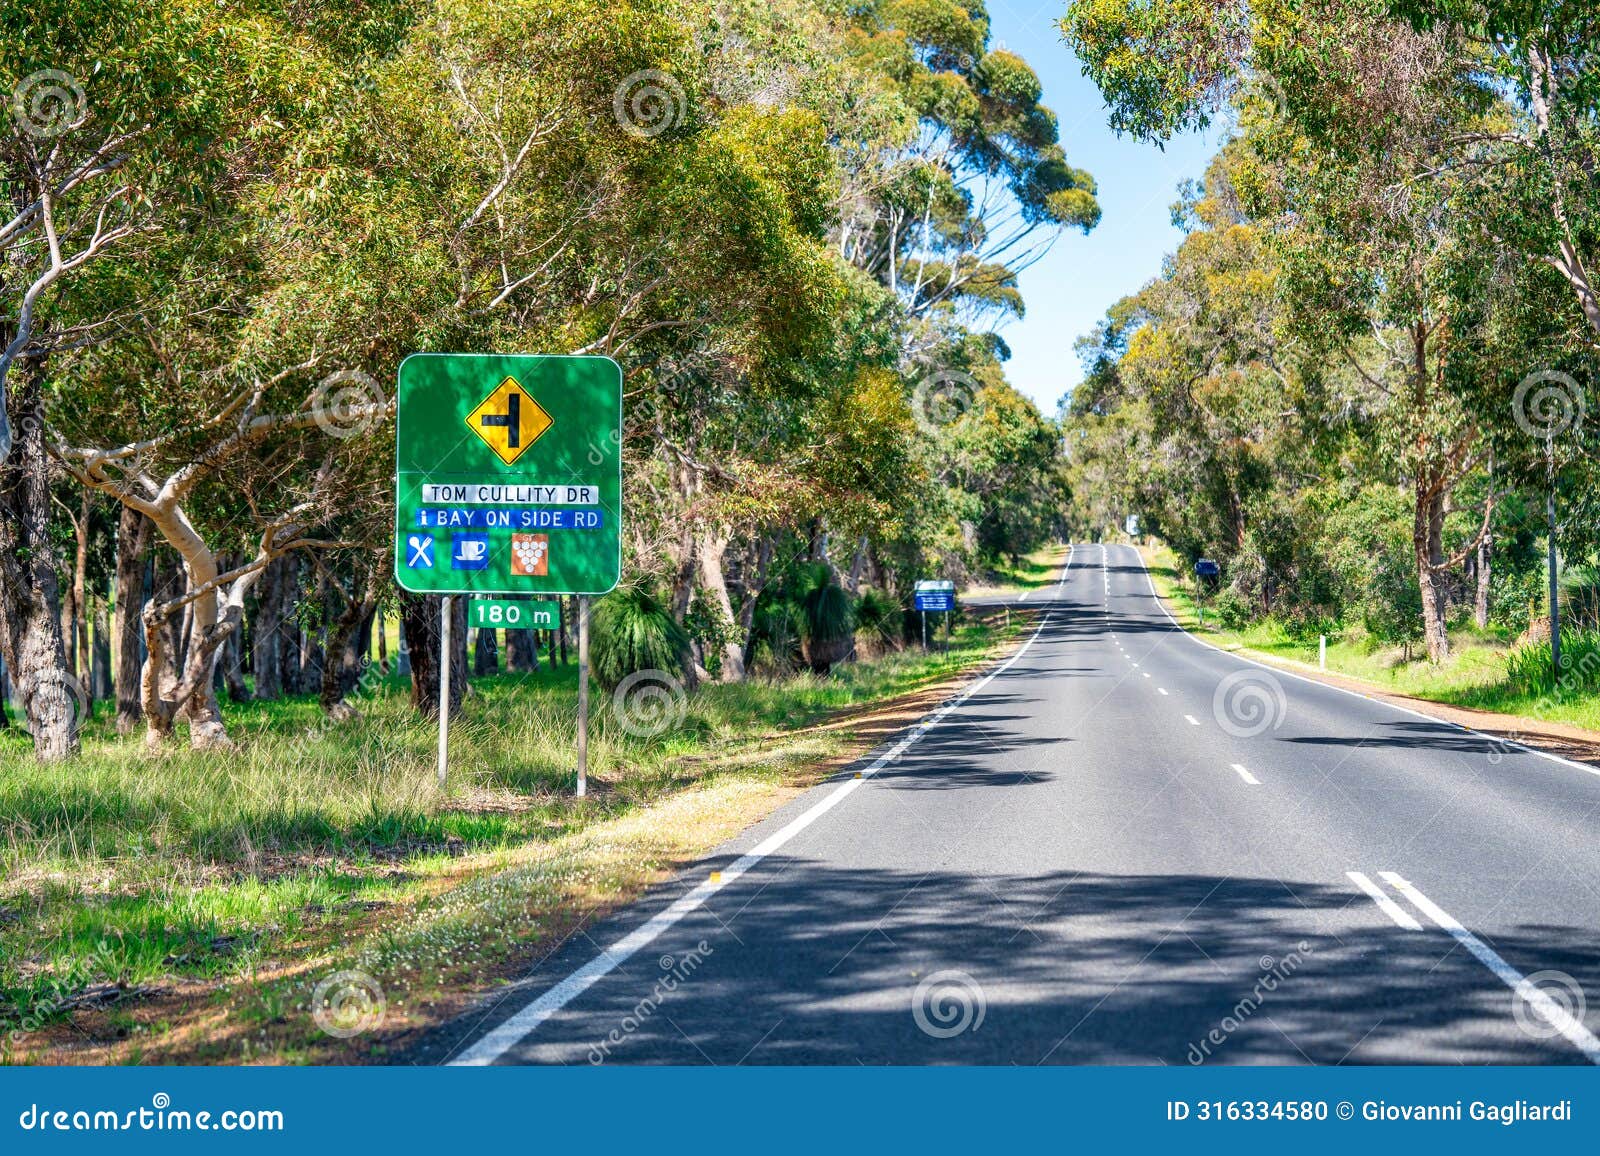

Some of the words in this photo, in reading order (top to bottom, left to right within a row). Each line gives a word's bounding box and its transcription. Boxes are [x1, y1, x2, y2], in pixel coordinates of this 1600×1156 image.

[431, 486, 467, 501] TOM
[478, 486, 557, 502] CULLITY
[567, 487, 590, 503] DR
[437, 510, 475, 526] BAY
[486, 510, 510, 527] ON
[521, 511, 563, 527] SIDE
[574, 512, 598, 527] RD
[477, 605, 520, 623] 180
[533, 612, 551, 624] m
